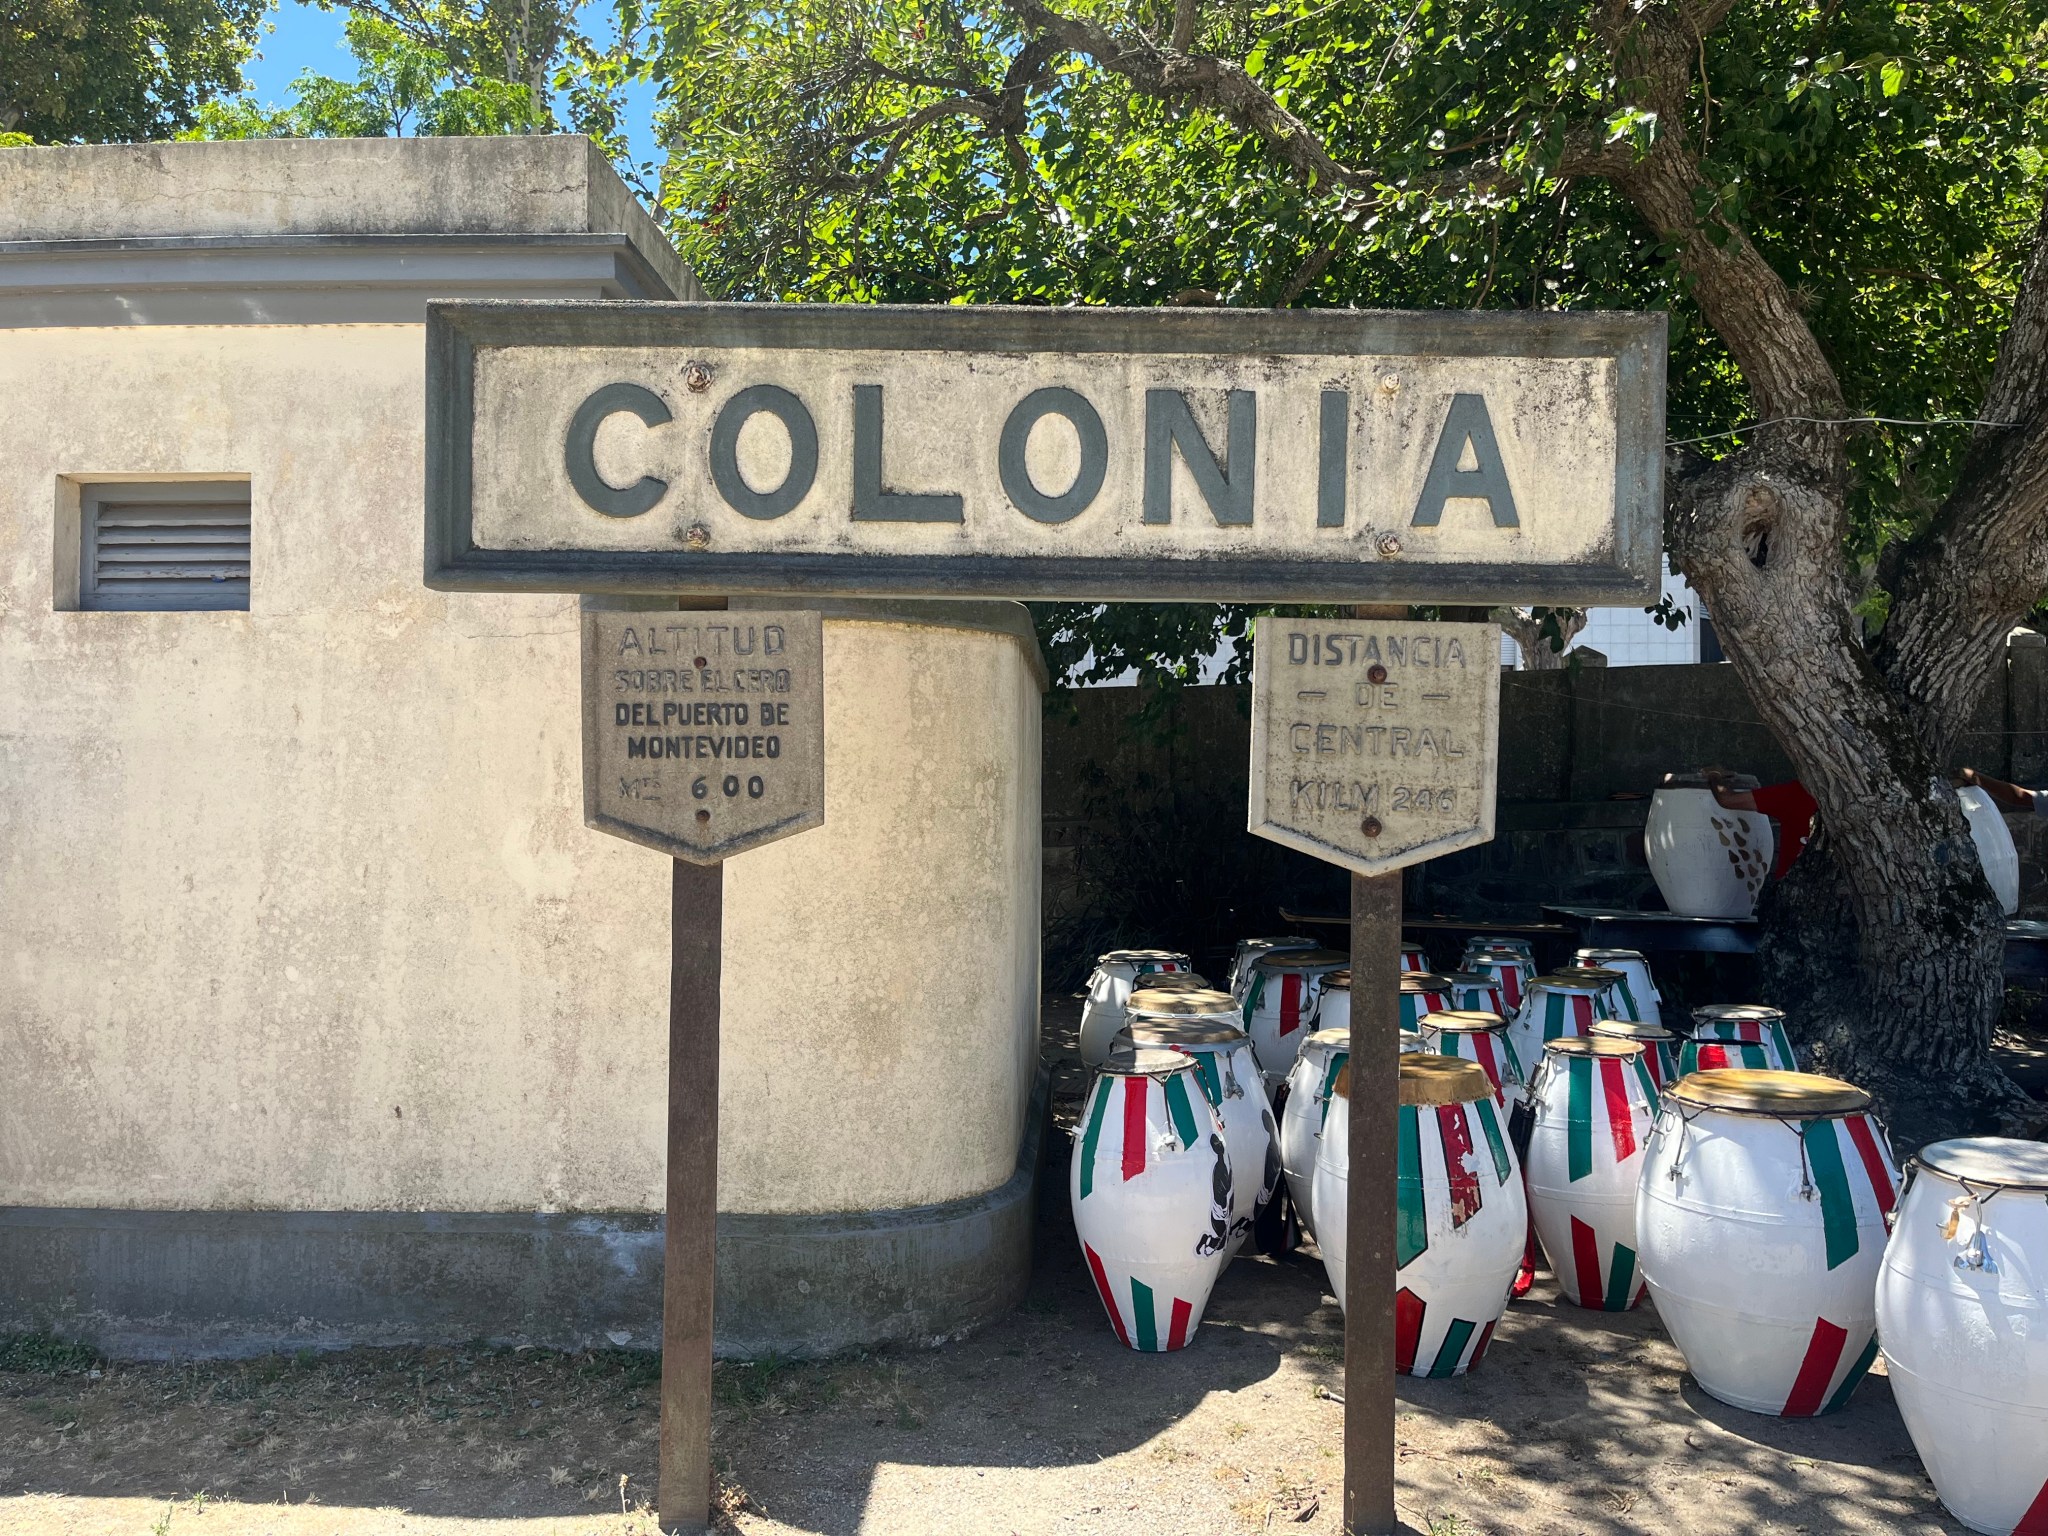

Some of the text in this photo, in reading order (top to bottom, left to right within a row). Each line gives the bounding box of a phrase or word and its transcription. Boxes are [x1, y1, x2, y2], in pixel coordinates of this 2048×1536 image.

[564, 381, 1521, 529] COLONIA
[618, 626, 786, 656] ALTITUD
[1288, 633, 1467, 668] DISTANCIA
[615, 669, 791, 693] SOBRE EL CERO
[1355, 682, 1399, 709] DE
[615, 702, 790, 726] DEL PUERTO DE
[627, 736, 781, 759] MONTEVIDEO
[1289, 722, 1465, 758] CENTRAL
